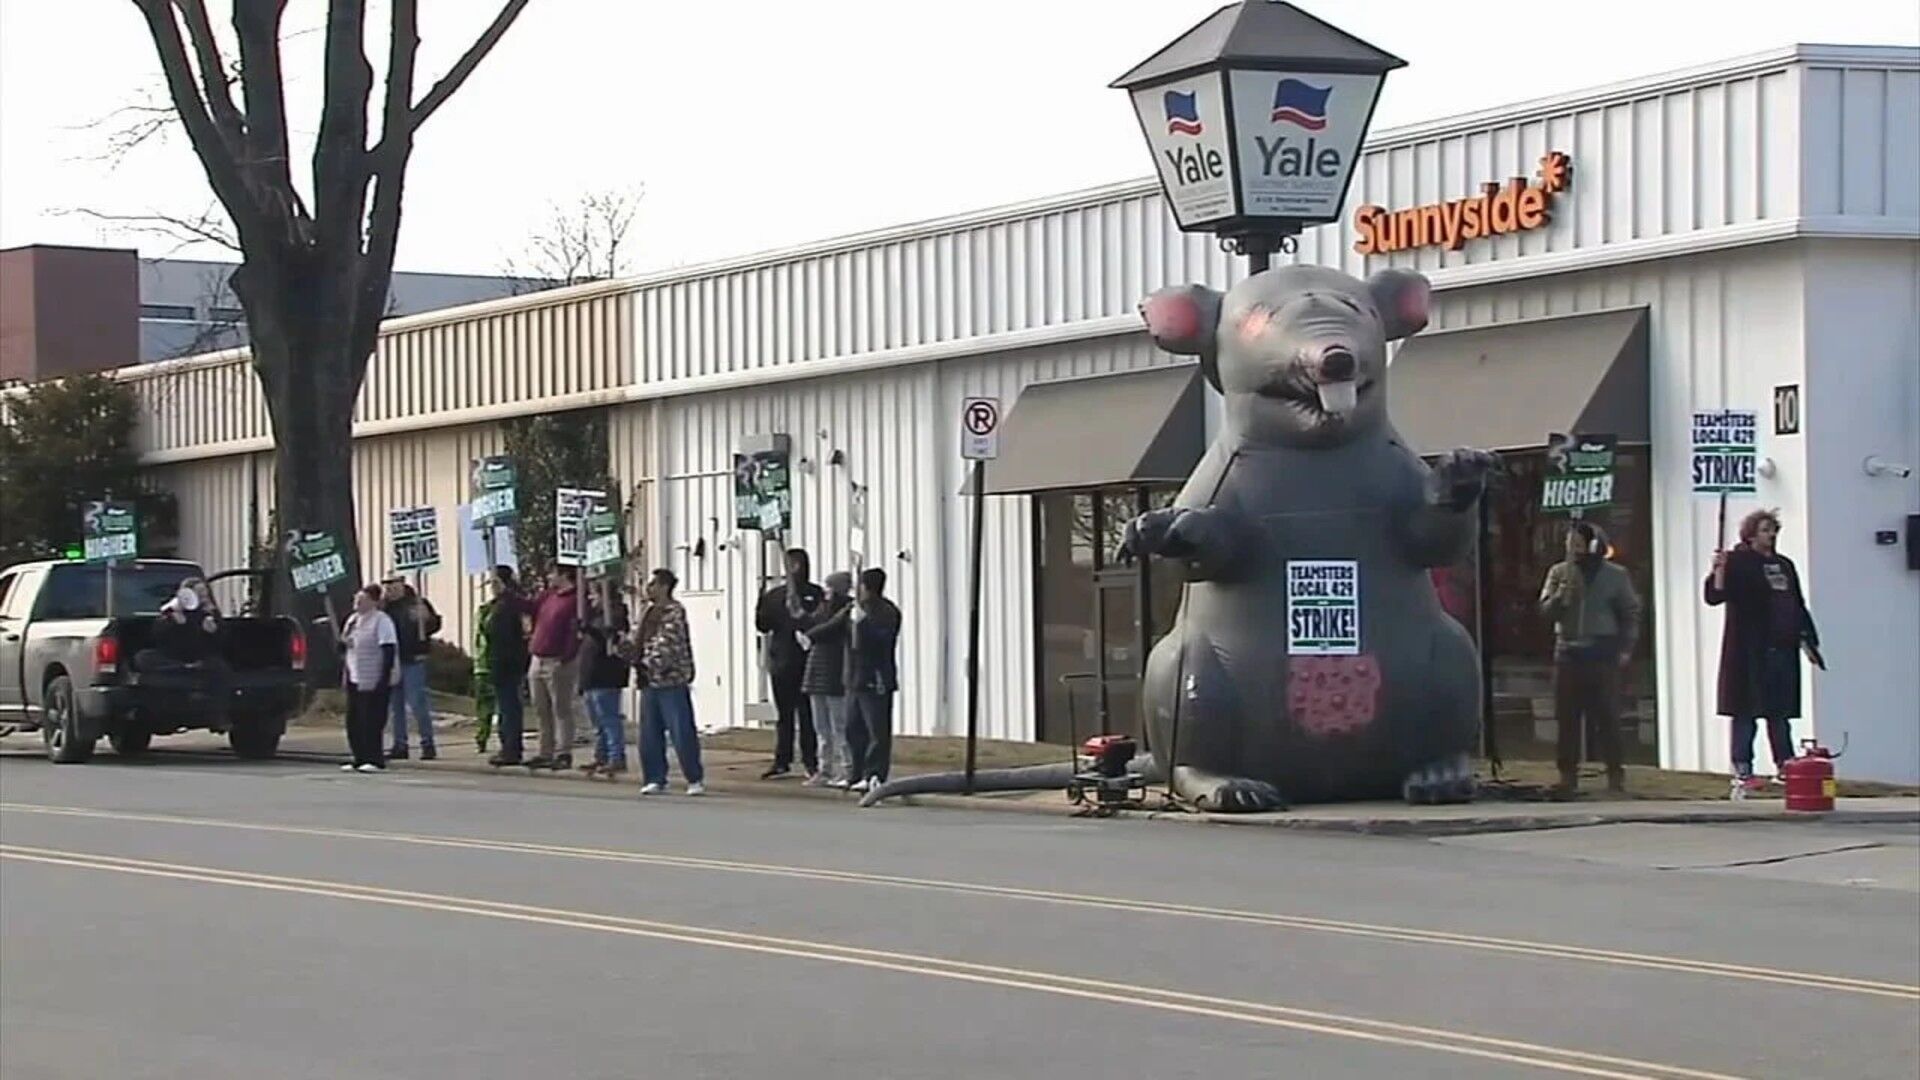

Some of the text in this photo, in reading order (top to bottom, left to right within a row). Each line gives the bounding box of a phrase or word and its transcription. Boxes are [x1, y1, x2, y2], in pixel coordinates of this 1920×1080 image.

[1165, 142, 1224, 186] Yale
[1255, 136, 1341, 177] Yale
[1354, 176, 1550, 255] Sunnyside
[1692, 413, 1755, 427] TEAMSTERS
[1774, 390, 1797, 430] 10
[1692, 429, 1731, 444] LOCAL
[1692, 454, 1756, 484] STRIKE!
[1542, 474, 1614, 507] HIGHER
[291, 553, 346, 590] HIGHER
[1290, 565, 1354, 580] TEAMSTERS
[1291, 581, 1354, 597] LOCAL 429
[1291, 607, 1356, 639] STRIKE!
